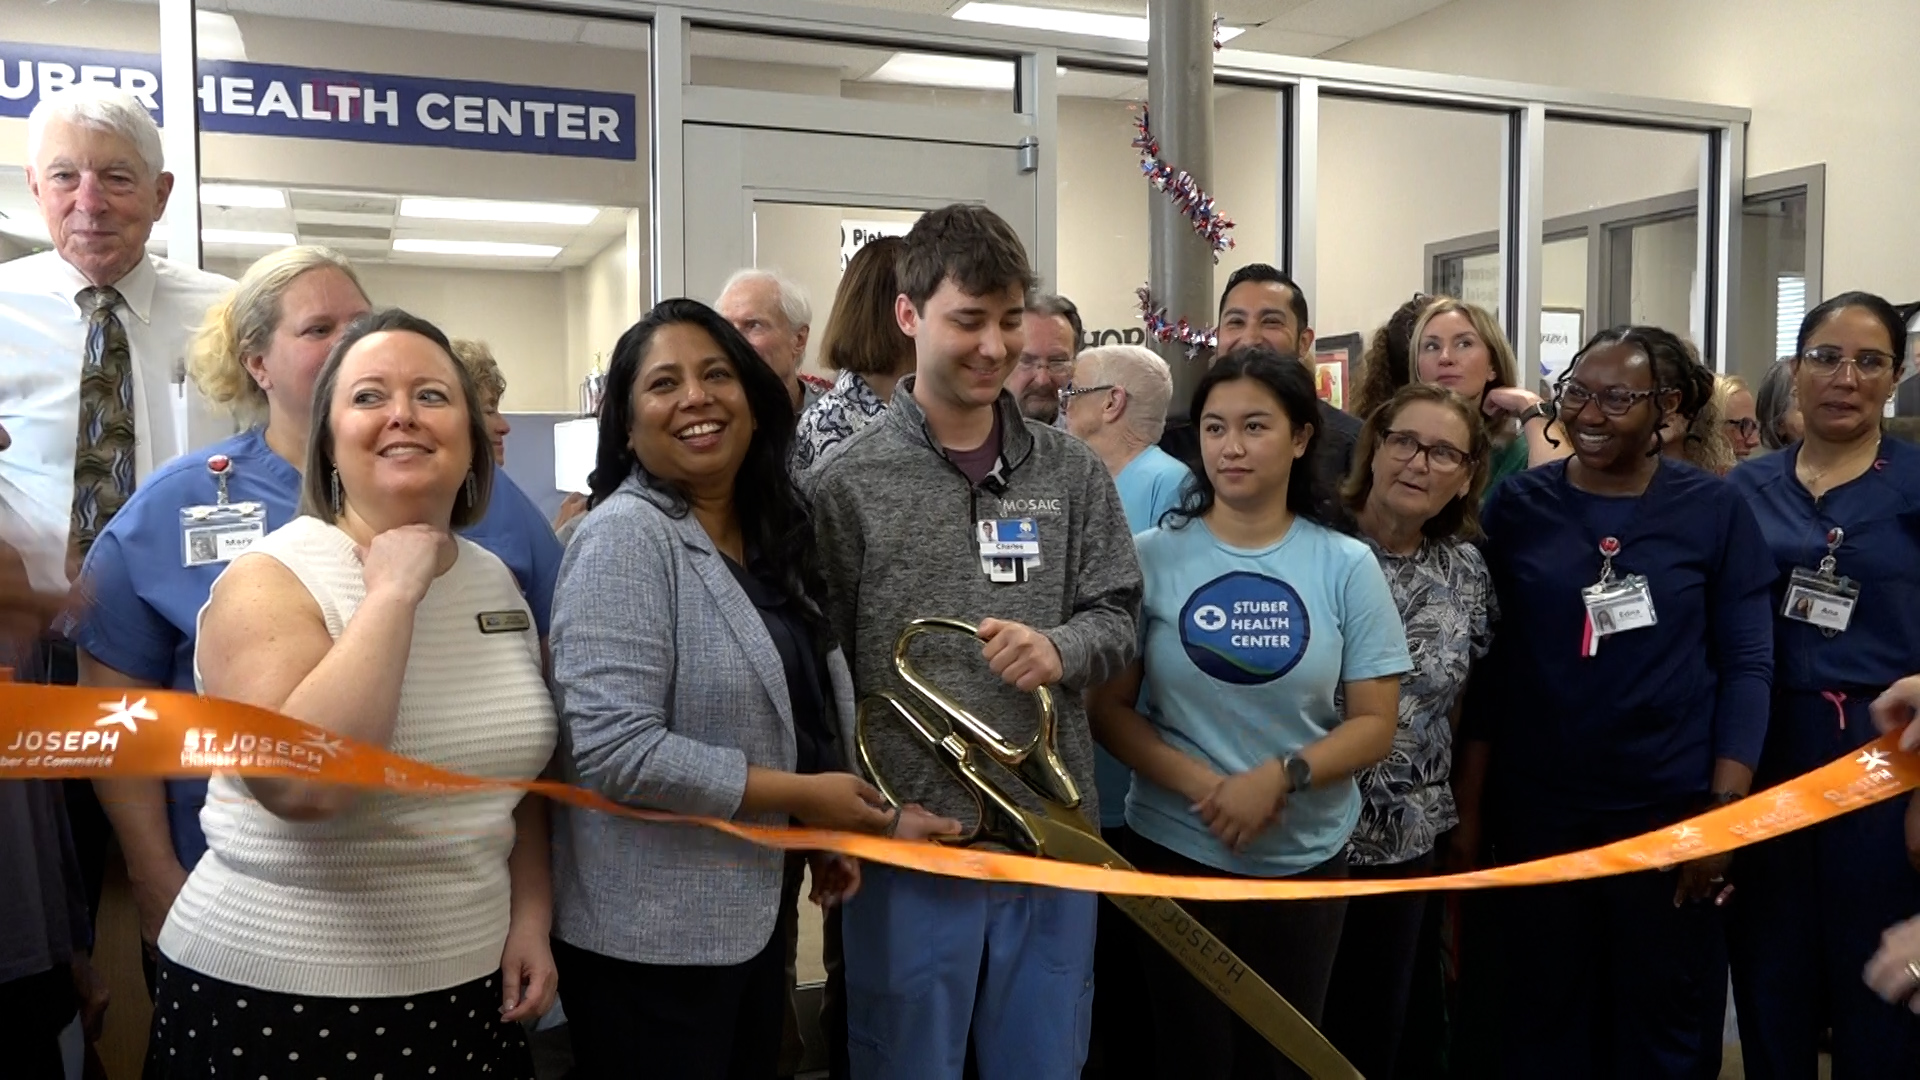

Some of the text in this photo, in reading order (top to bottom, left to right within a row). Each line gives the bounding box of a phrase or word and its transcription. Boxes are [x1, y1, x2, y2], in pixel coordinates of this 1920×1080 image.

[416, 92, 621, 143] CENTER
[1003, 498, 1062, 513] MOSAIC
[1233, 600, 1289, 615] STUBER
[1231, 617, 1290, 631] HEALTH
[1231, 634, 1291, 649] CENTER
[7, 730, 120, 752] JOSEPH
[223, 732, 323, 764] JOSEPH
[1158, 905, 1246, 984] JOSEPH
